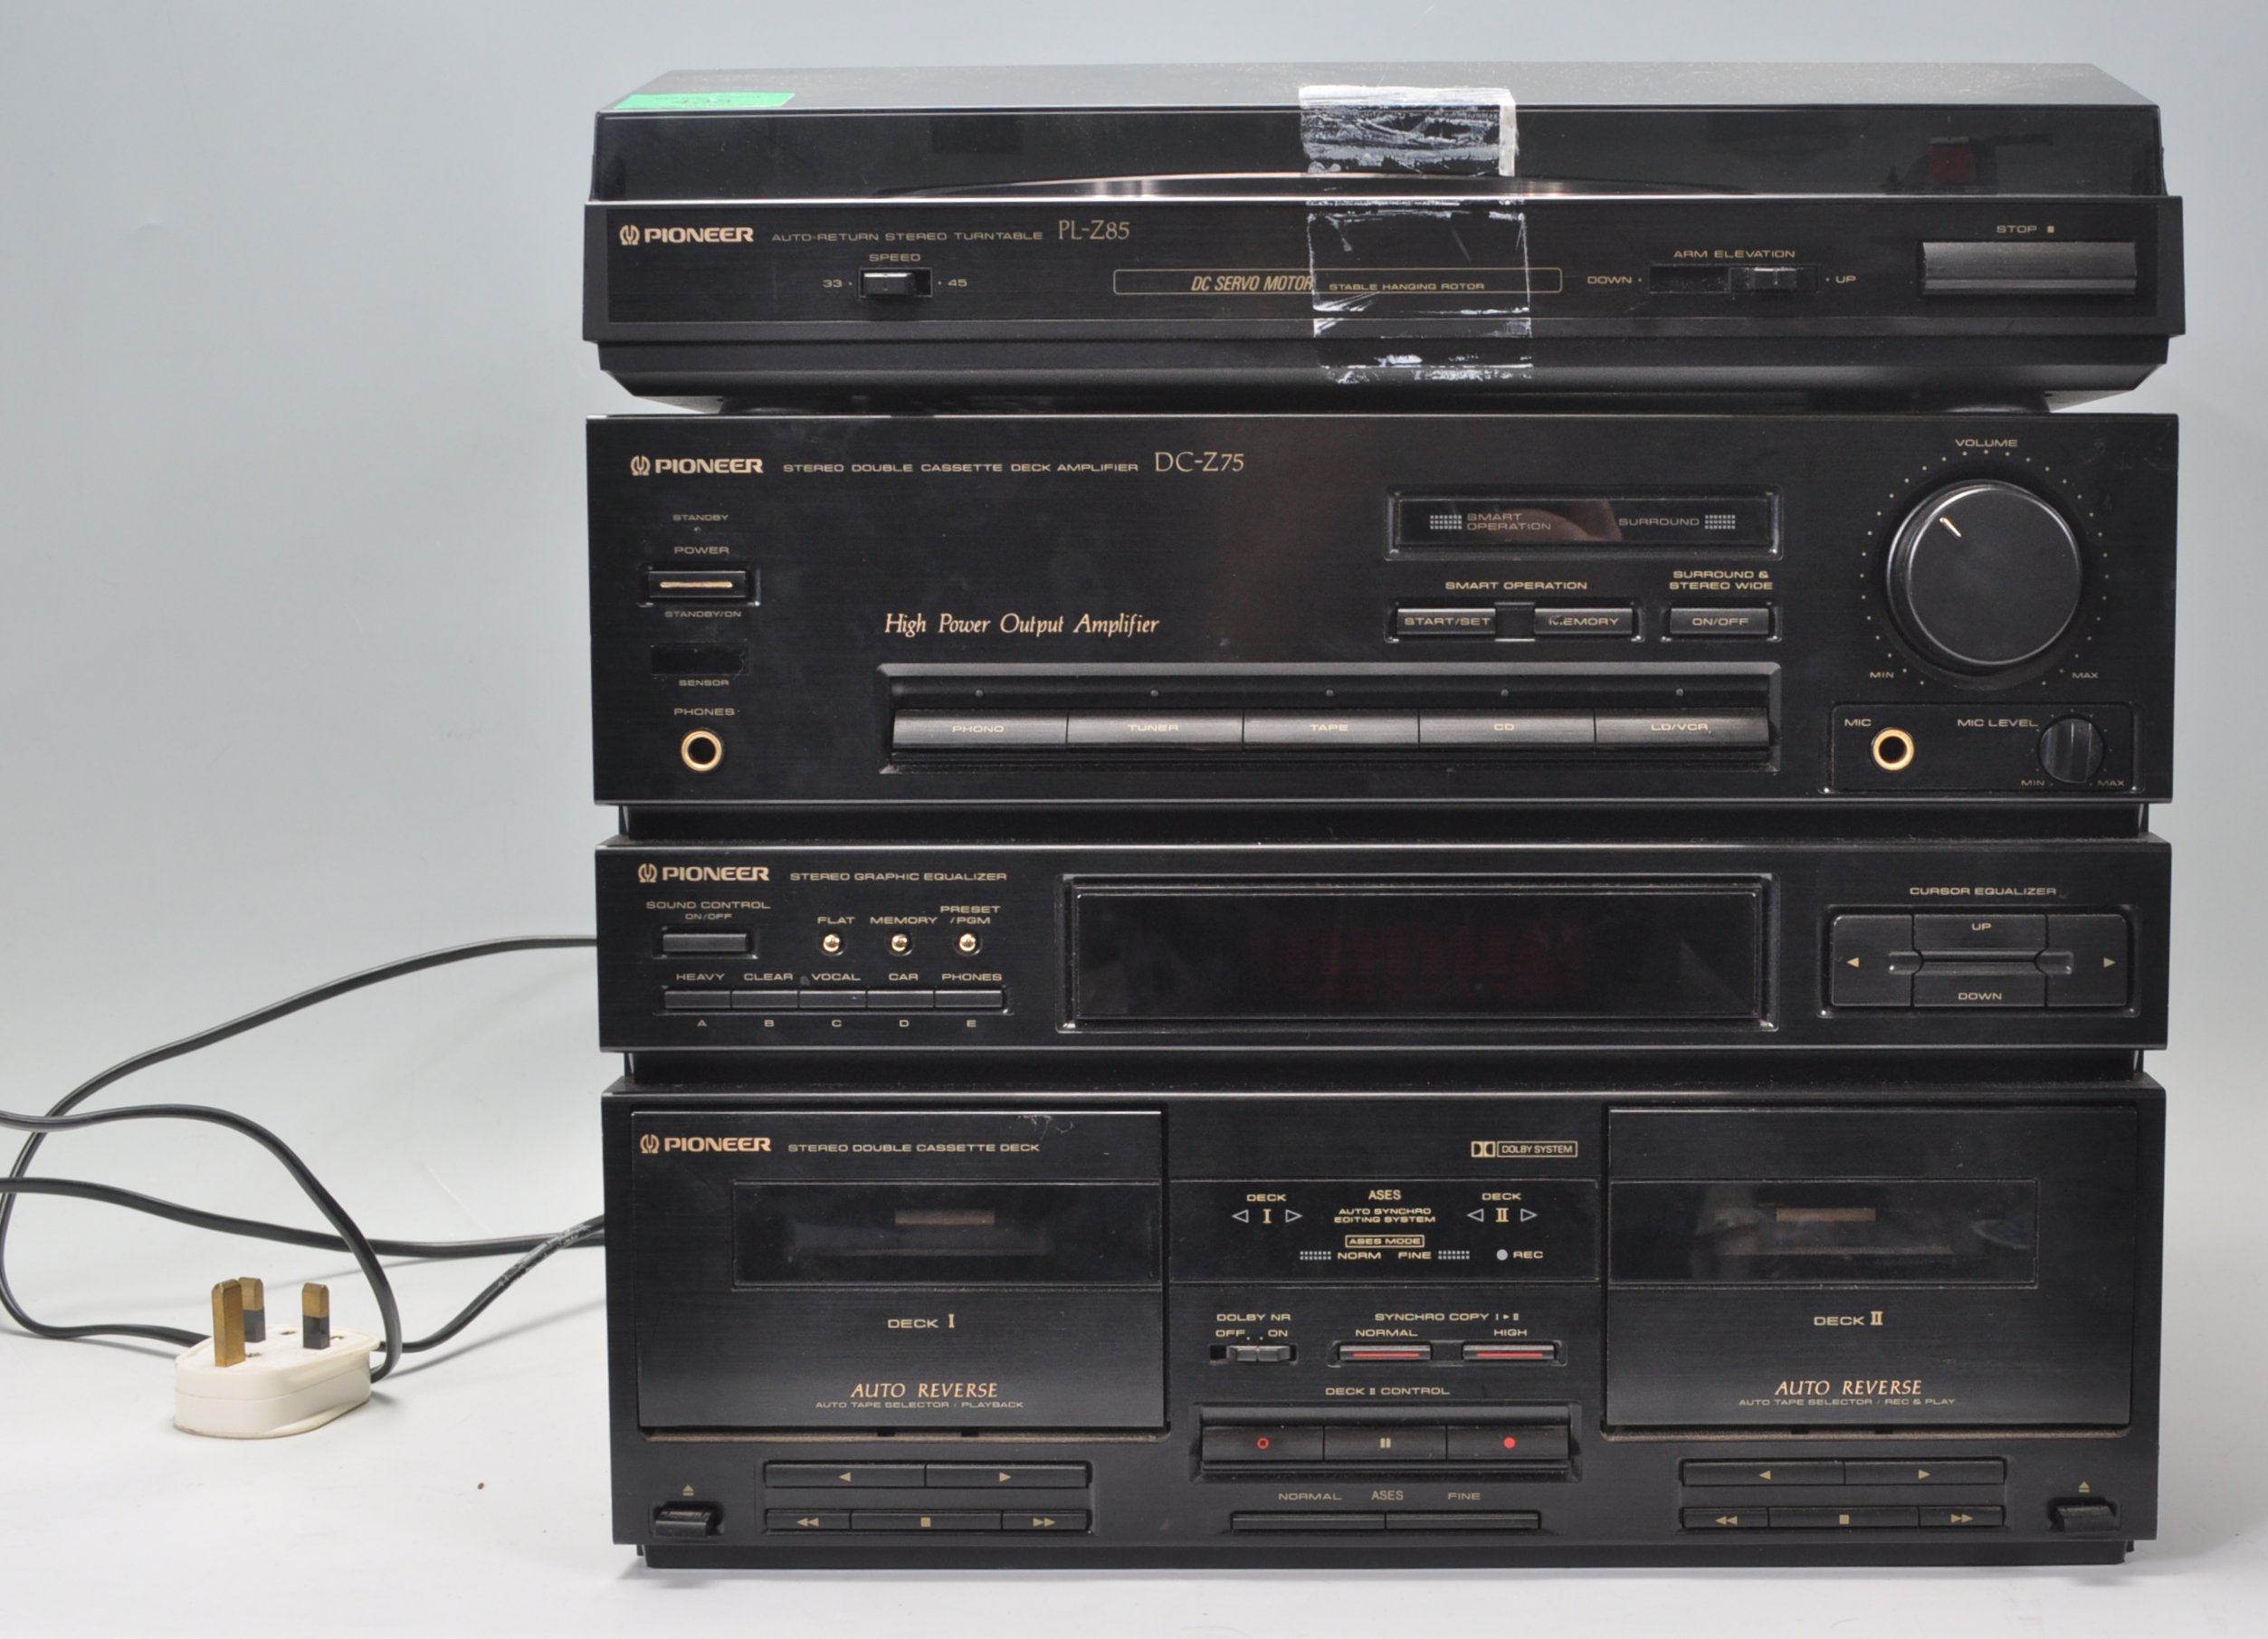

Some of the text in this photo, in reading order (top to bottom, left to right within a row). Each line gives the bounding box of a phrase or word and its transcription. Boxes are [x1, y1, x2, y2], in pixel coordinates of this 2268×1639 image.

[1059, 220, 1129, 240] PL-Z85
[1996, 224, 2038, 234] STOP
[644, 227, 753, 243] PIONEER
[884, 232, 948, 242] STEREO
[953, 231, 1043, 241] TURNTABLE
[868, 253, 921, 262] SPEED
[1672, 249, 1796, 259] ARM ELEVATION
[948, 278, 968, 288] 45
[1191, 276, 1314, 291] DC SERVO MOTOR
[1587, 275, 1633, 285] DOWN
[1834, 274, 1857, 284] UP
[823, 279, 843, 289] 33
[1329, 282, 1486, 291] STABLE HANGING ROTOR
[1955, 438, 2018, 448] VOLUME
[655, 459, 763, 473] PIONEER
[1155, 452, 1244, 472] DC-Z75
[783, 463, 1139, 473] STEREO DOUBLE CASSETTE DECK AMPLIFIER
[672, 513, 729, 521] STANDBY
[1467, 512, 1523, 522] SMART
[1466, 521, 1552, 531] OPERATION
[1617, 517, 1701, 527] SURROUND
[673, 546, 730, 555] POWER
[1672, 570, 1769, 579] SURROUND &
[1444, 581, 1587, 590] SMART OPERATION
[1669, 581, 1773, 590] STEREO WIDE
[664, 610, 742, 618] STANDBY/ON
[885, 613, 1159, 637] High Power Output Amplifier
[1404, 616, 1491, 626] START/SET
[1691, 617, 1749, 626] ON/OFF
[1869, 671, 1894, 679] MIN
[678, 679, 729, 687] SENSOR
[673, 707, 736, 717] PHONES
[1308, 723, 1349, 732] TAPE
[1492, 722, 1516, 731] CD
[1651, 723, 1709, 731] LD/VCR
[1844, 718, 1872, 728] MIC
[1957, 718, 2039, 728] MIC LEVEL
[951, 725, 1005, 733] PHONO
[1127, 724, 1179, 732] TUNER
[2097, 779, 2125, 787] MAX
[662, 867, 769, 881] PIONEER
[789, 872, 1007, 881] STEREO GRAPHIC EQUALIZER
[1909, 887, 2057, 896] CURSOR EQUALIZER
[645, 900, 771, 910] SOUND CONTROL
[939, 905, 1001, 914] PRESET
[816, 916, 855, 925] FLAT
[869, 916, 938, 925] MEMORY
[1971, 922, 1992, 931] UP
[675, 973, 725, 981] HEAVY
[743, 972, 794, 981] CLEAR
[811, 972, 862, 982] VOCAL
[888, 972, 919, 982] CAR
[941, 972, 1003, 982] PHONES
[1958, 992, 2003, 1001] DOWN
[697, 1019, 708, 1027] A
[764, 1019, 775, 1028] B
[831, 1019, 843, 1028] C
[899, 1019, 910, 1028] D
[966, 1019, 977, 1028] E
[664, 1138, 771, 1151] PIONEER
[787, 1143, 1040, 1153] STEREO DOUBLE CASSETTE DECK
[1501, 1144, 1574, 1155] DOLBY SYSTEM
[1246, 1193, 1287, 1203] DECK
[1367, 1189, 1402, 1201] ASES
[1481, 1192, 1521, 1201] DECK
[1338, 1207, 1432, 1215] AUTO SYNCHRO
[1333, 1215, 1436, 1224] EDITING SYSTEM
[1348, 1237, 1422, 1248] ASES MODE
[1337, 1251, 1382, 1261] NORM
[1397, 1251, 1432, 1260] FINE
[1512, 1250, 1544, 1260] REC
[1215, 1313, 1291, 1322] DOLBY NR
[1374, 1312, 1445, 1321] SYNCHRO
[1448, 1312, 1490, 1321] COPY
[887, 1318, 939, 1329] DECK
[1813, 1316, 1865, 1327] DECK
[1215, 1329, 1246, 1338] OFF
[1267, 1329, 1289, 1338] ON
[1355, 1329, 1419, 1338] NORMAL
[1493, 1328, 1528, 1337] HIGH
[851, 1383, 996, 1397] AUTO REVERSE
[1325, 1386, 1366, 1396] DECK
[1380, 1386, 1451, 1396] CONTROL
[1775, 1380, 1921, 1395] AUTO REVERSE
[815, 1401, 848, 1409] AUTO
[850, 1401, 881, 1409] TAPE
[884, 1401, 950, 1409] SELECTOR
[1738, 1398, 1771, 1406] AUTO
[1773, 1398, 1805, 1406] TAPE
[1807, 1398, 1873, 1406] SELECTOR
[1884, 1397, 1910, 1406] REC
[1924, 1397, 1956, 1406] PLAY
[1278, 1492, 1342, 1501] NORMAL
[1371, 1490, 1405, 1501] ASES
[1447, 1491, 1481, 1501] FINE
